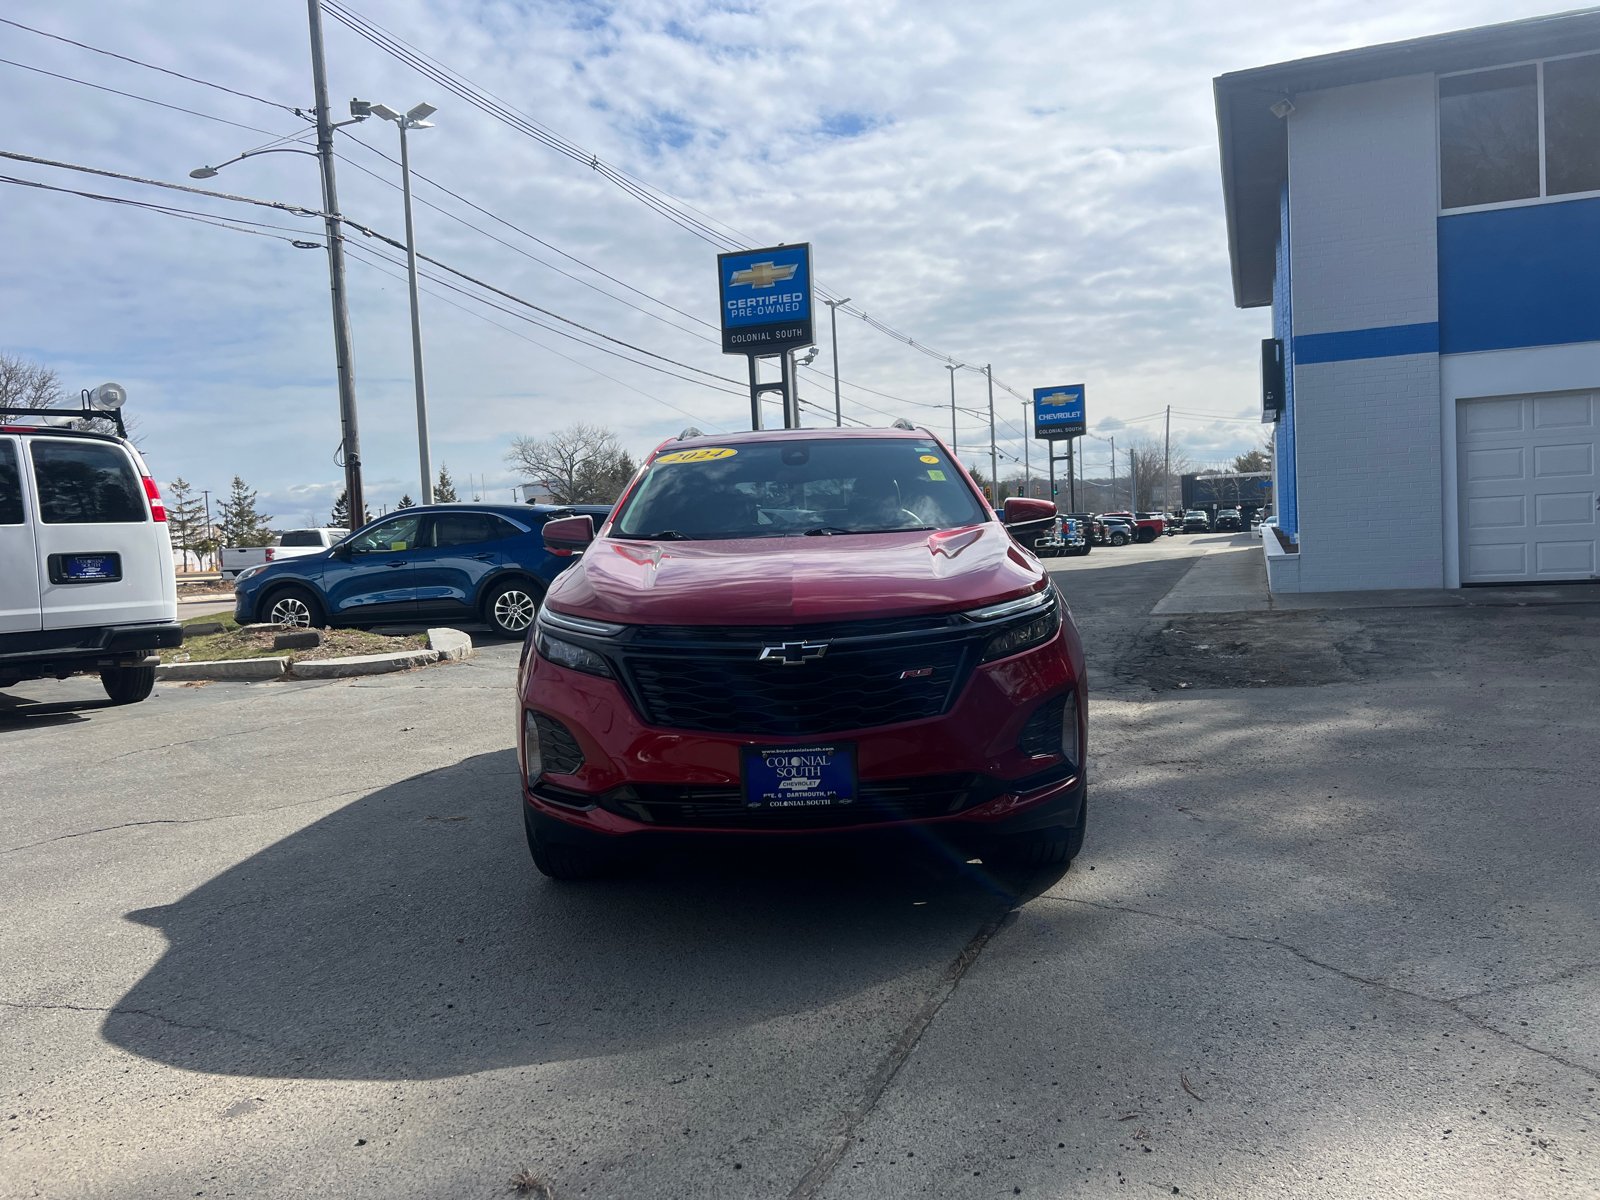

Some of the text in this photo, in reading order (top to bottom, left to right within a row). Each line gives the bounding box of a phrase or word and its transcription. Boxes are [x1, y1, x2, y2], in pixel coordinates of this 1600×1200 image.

[727, 292, 803, 309] CERTIFIED
[731, 302, 800, 318] PRE-OWNED
[731, 328, 803, 343] COLONIAL SOUTH
[1038, 410, 1082, 421] CHEVROLET
[1038, 427, 1064, 435] COLONIAL
[667, 448, 728, 463] 2024
[899, 667, 934, 679] RS
[761, 747, 835, 755] www.buycolonialsouth.com
[766, 755, 831, 768] COLONIAL
[776, 766, 821, 778] SOUTH
[782, 780, 817, 788] CHEVROLET
[786, 790, 827, 799] DARTMOUTH,
[769, 800, 806, 808] COLONIAL
